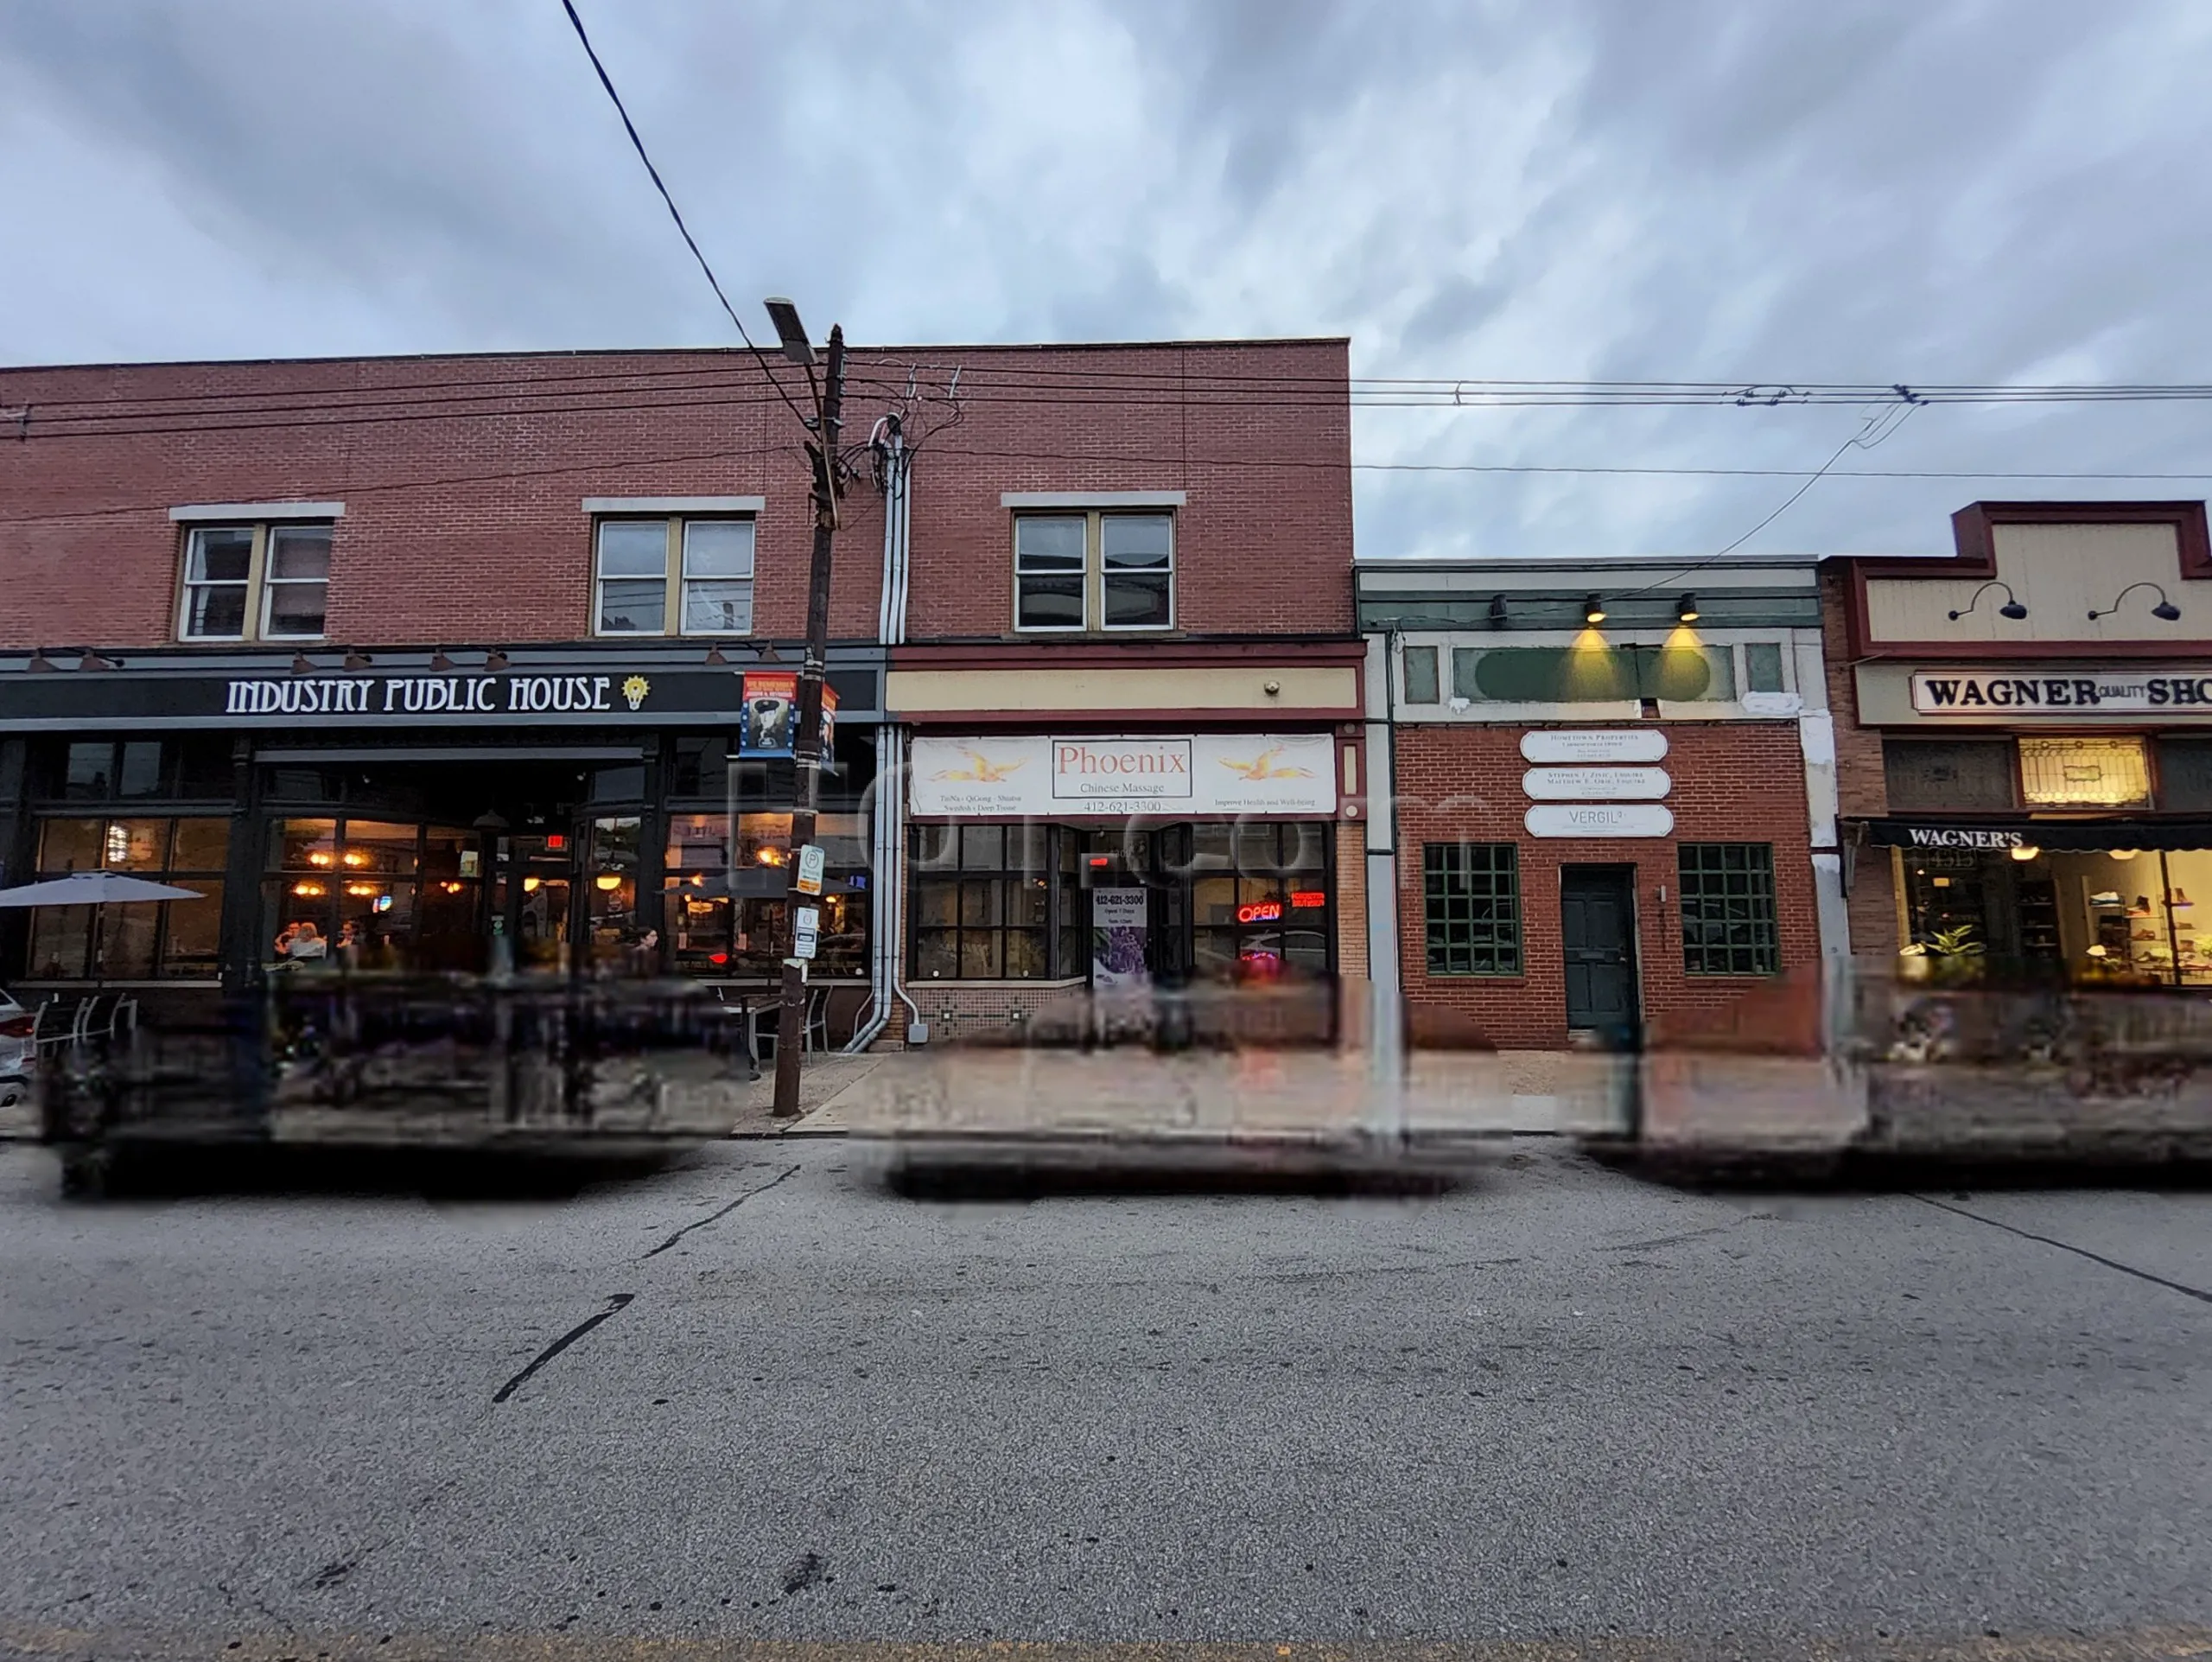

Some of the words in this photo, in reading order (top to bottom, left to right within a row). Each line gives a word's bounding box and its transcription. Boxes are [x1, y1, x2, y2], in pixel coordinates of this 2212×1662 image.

[226, 679, 375, 713] INDUSTRY
[383, 678, 497, 711] PUBLIC
[508, 677, 612, 711] HOUSE
[1924, 678, 2101, 706] WAGNER
[2099, 685, 2145, 698] QUALITY
[1057, 746, 1187, 774] Phoenix
[1080, 782, 1120, 793] Chinese
[1122, 782, 1165, 794] Massage
[1084, 801, 1161, 812] 412-621-3300
[1214, 798, 1243, 807] Improve
[1243, 798, 1266, 806] Health
[1266, 798, 1279, 806] and
[1908, 828, 2024, 848] WAGNER'S
[1096, 895, 1144, 906] 412-621-3300
[1238, 903, 1281, 923] OPEN
